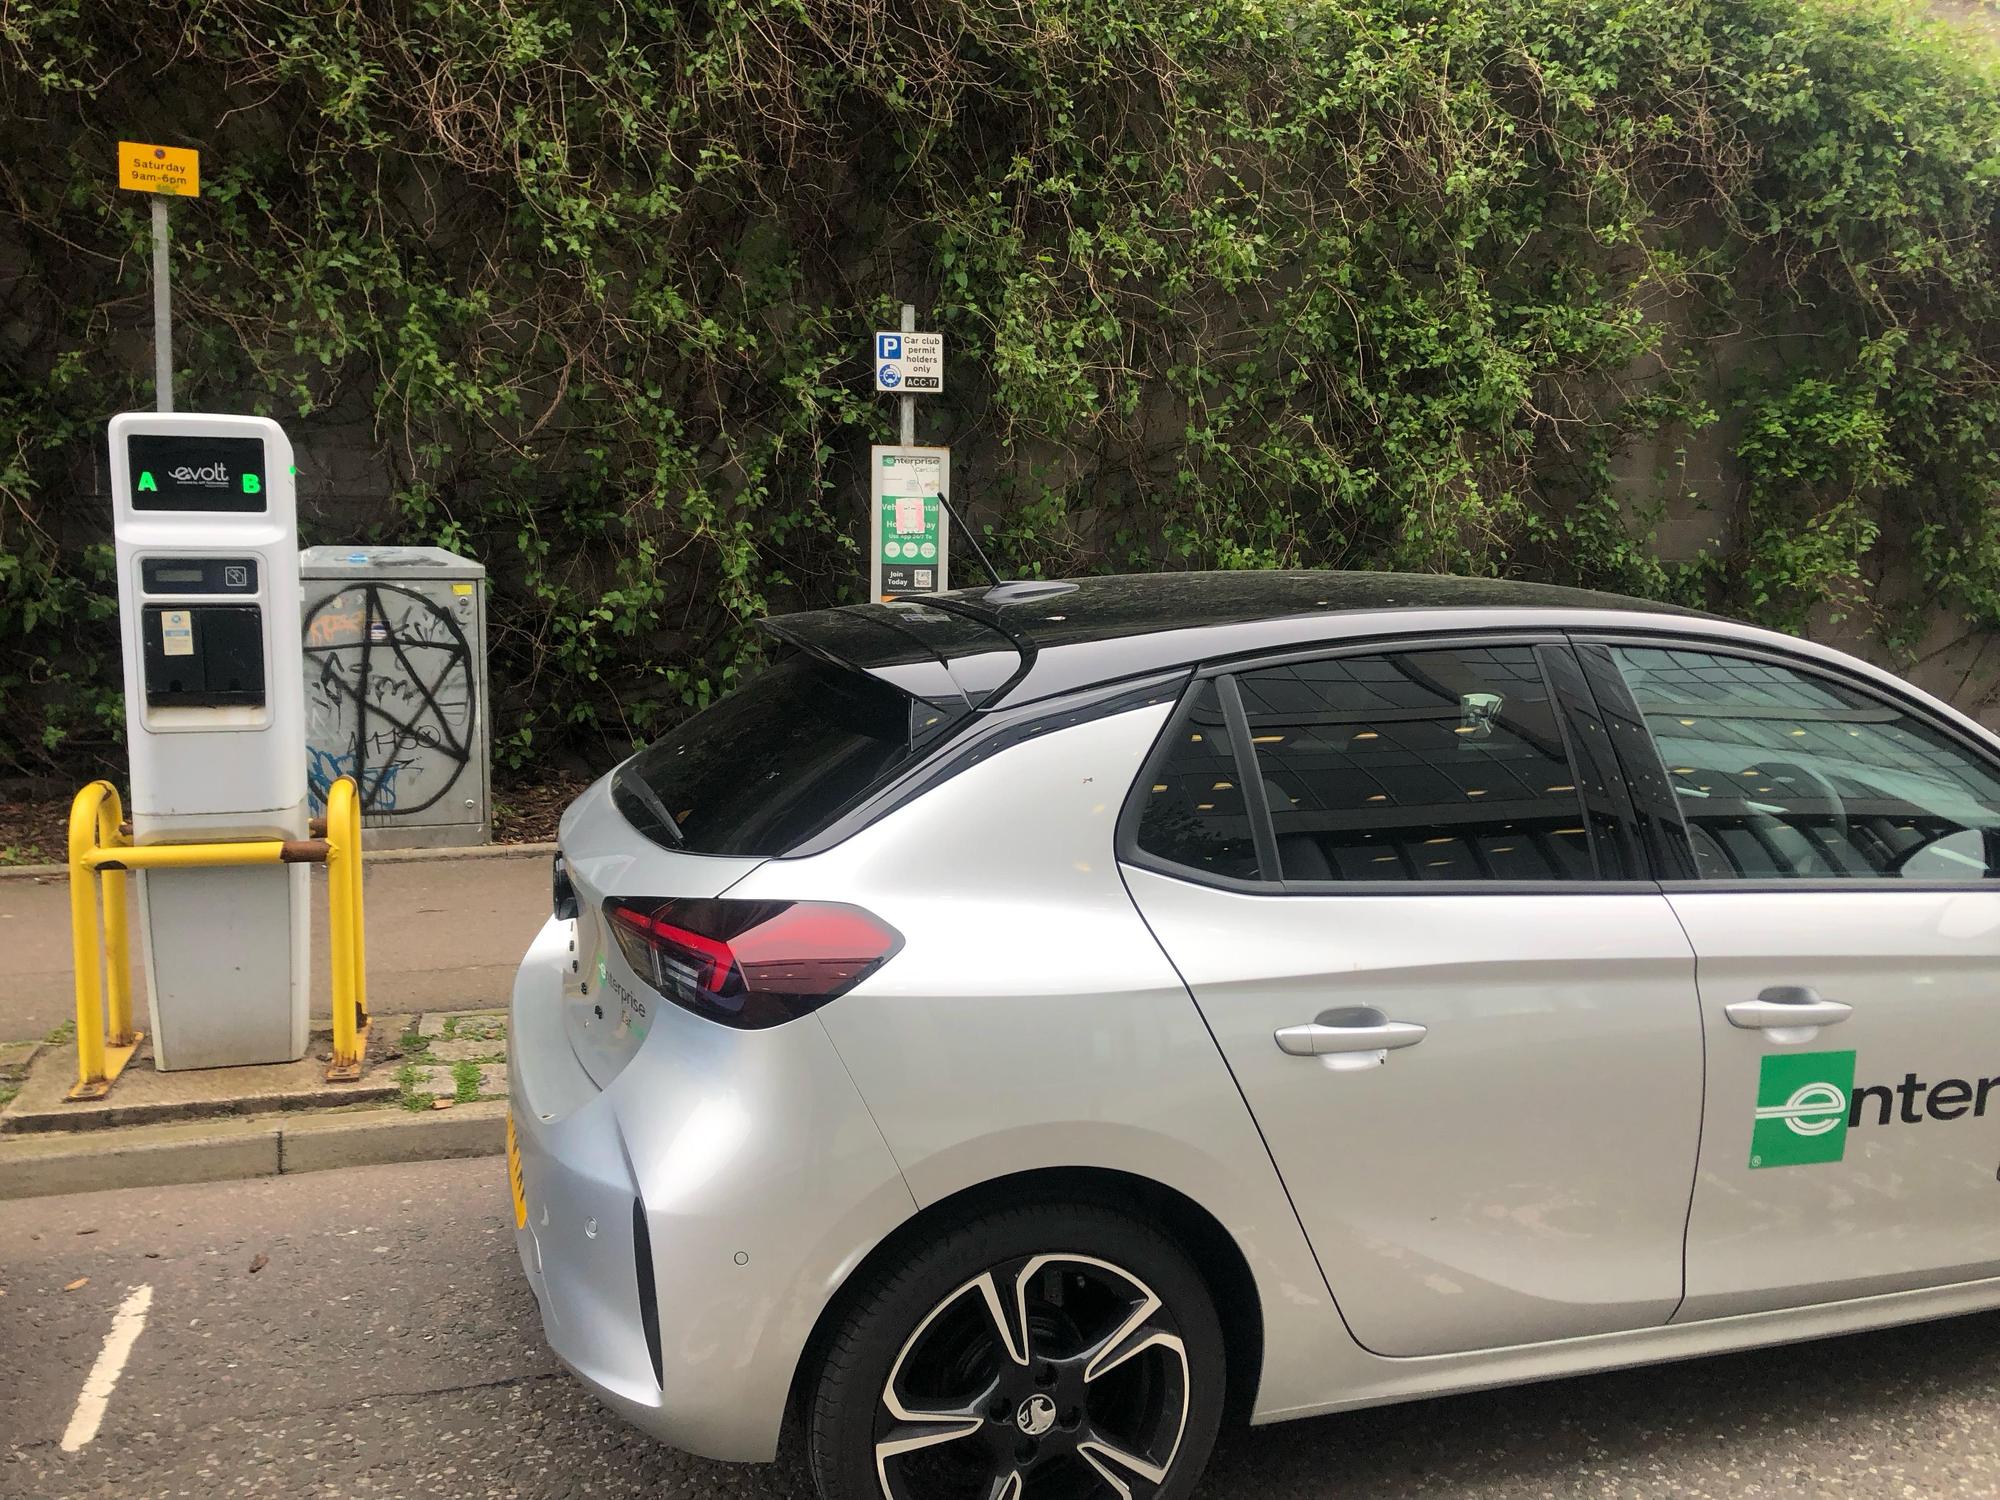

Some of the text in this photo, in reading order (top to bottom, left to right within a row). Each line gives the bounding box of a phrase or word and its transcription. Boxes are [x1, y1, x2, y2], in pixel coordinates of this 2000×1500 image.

[133, 158, 186, 174] Saturday
[131, 170, 187, 185] 9am-6pm
[903, 336, 940, 345] Car club
[883, 337, 898, 357] P
[908, 346, 936, 354] permit
[906, 355, 938, 364] holders
[913, 365, 931, 374] only
[906, 378, 938, 387] ACC-17
[168, 462, 230, 481] evolt
[137, 471, 158, 492] A
[242, 473, 262, 494] B
[889, 571, 904, 579] Join
[887, 578, 908, 587] Today
